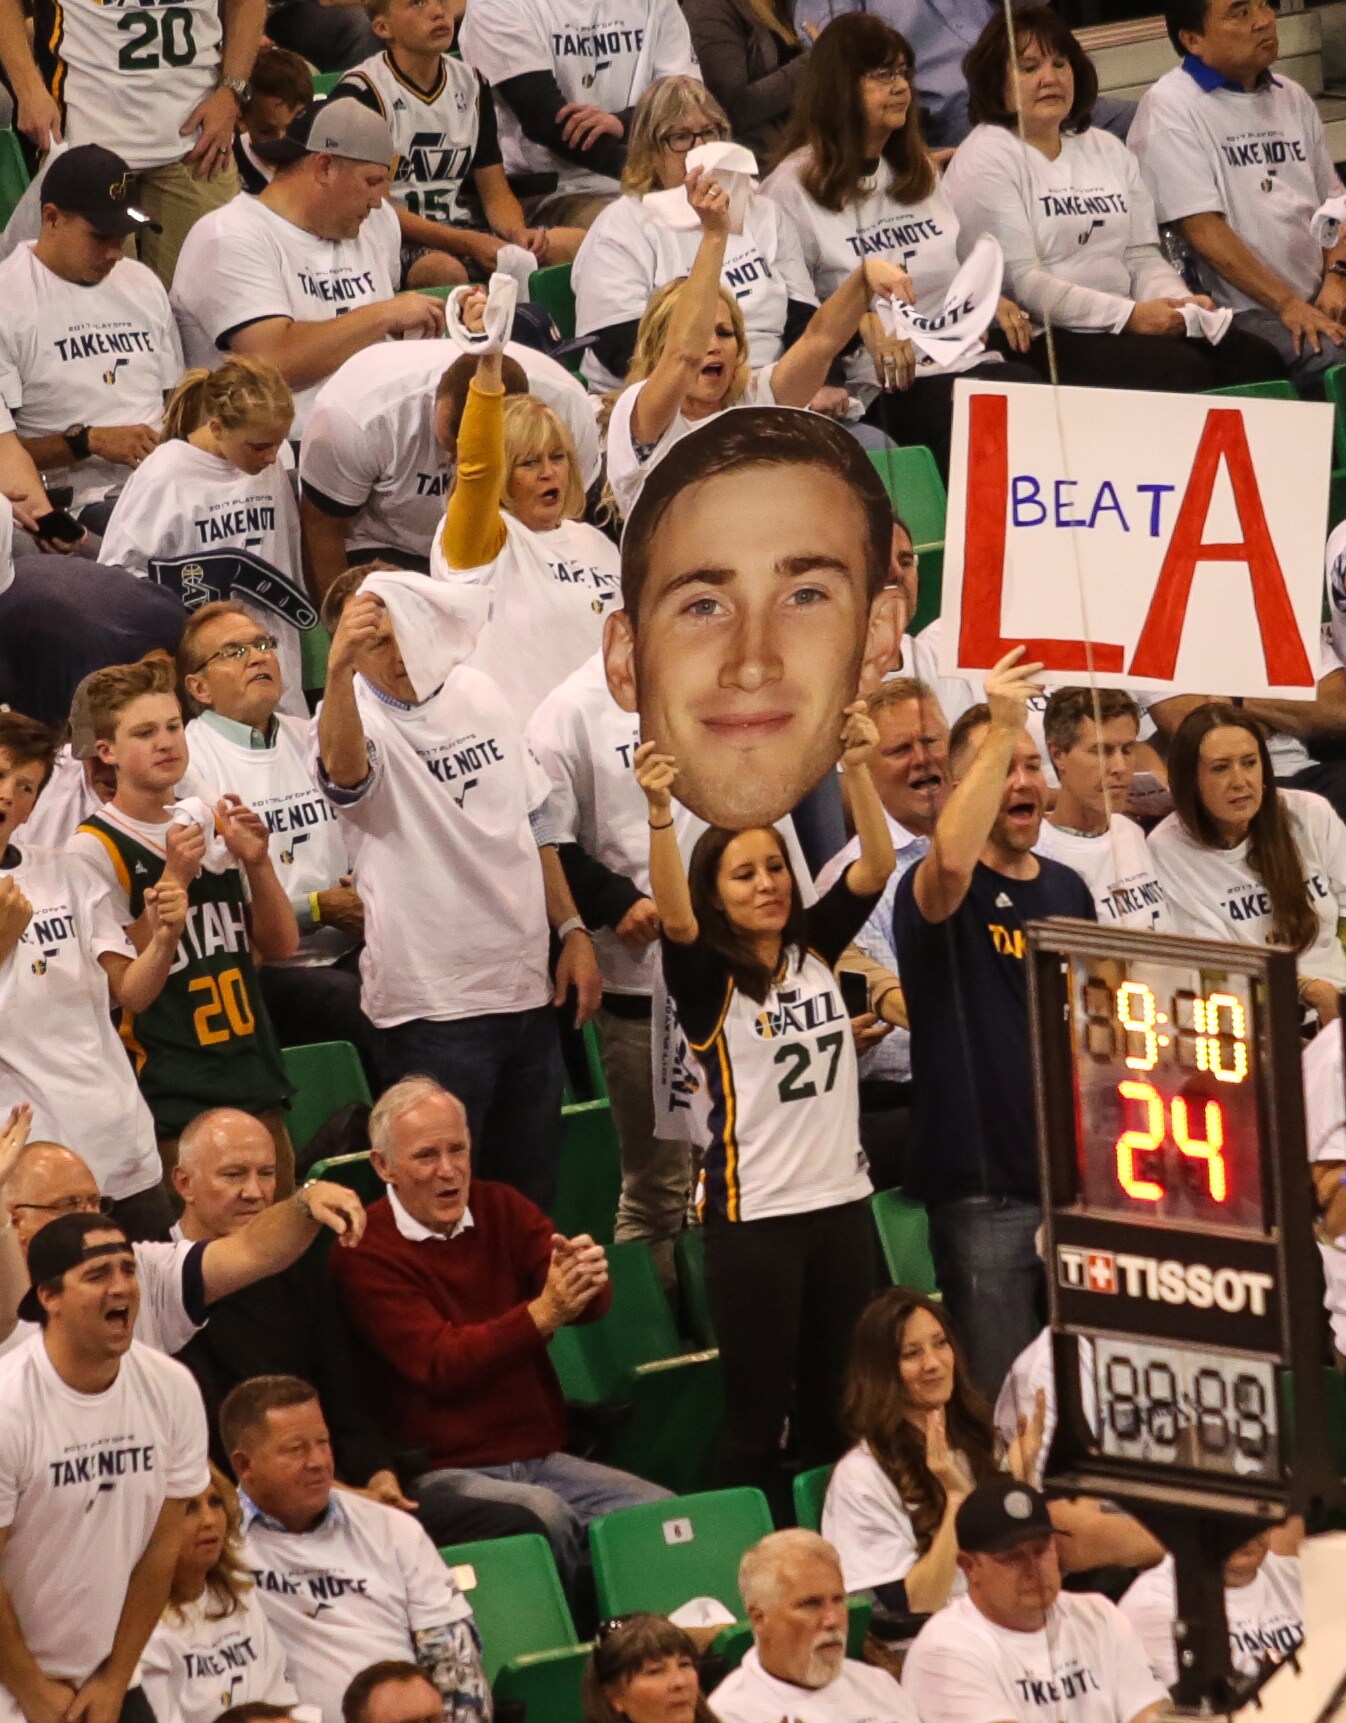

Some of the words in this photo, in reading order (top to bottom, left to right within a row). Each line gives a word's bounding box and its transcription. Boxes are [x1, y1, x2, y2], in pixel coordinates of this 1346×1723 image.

[117, 7, 197, 70] 20
[725, 256, 772, 287] NOT
[1011, 474, 1176, 538] BEAT
[957, 394, 1315, 688] LA
[33, 914, 76, 946] NOT
[1221, 894, 1271, 921] AKE
[188, 967, 255, 1047] 20
[754, 989, 846, 1040] JAZZ
[1116, 979, 1249, 1084] 9:10
[773, 1030, 844, 1103] 27
[1115, 1080, 1227, 1203] 24
[1116, 1253, 1274, 1317] TISSOT
